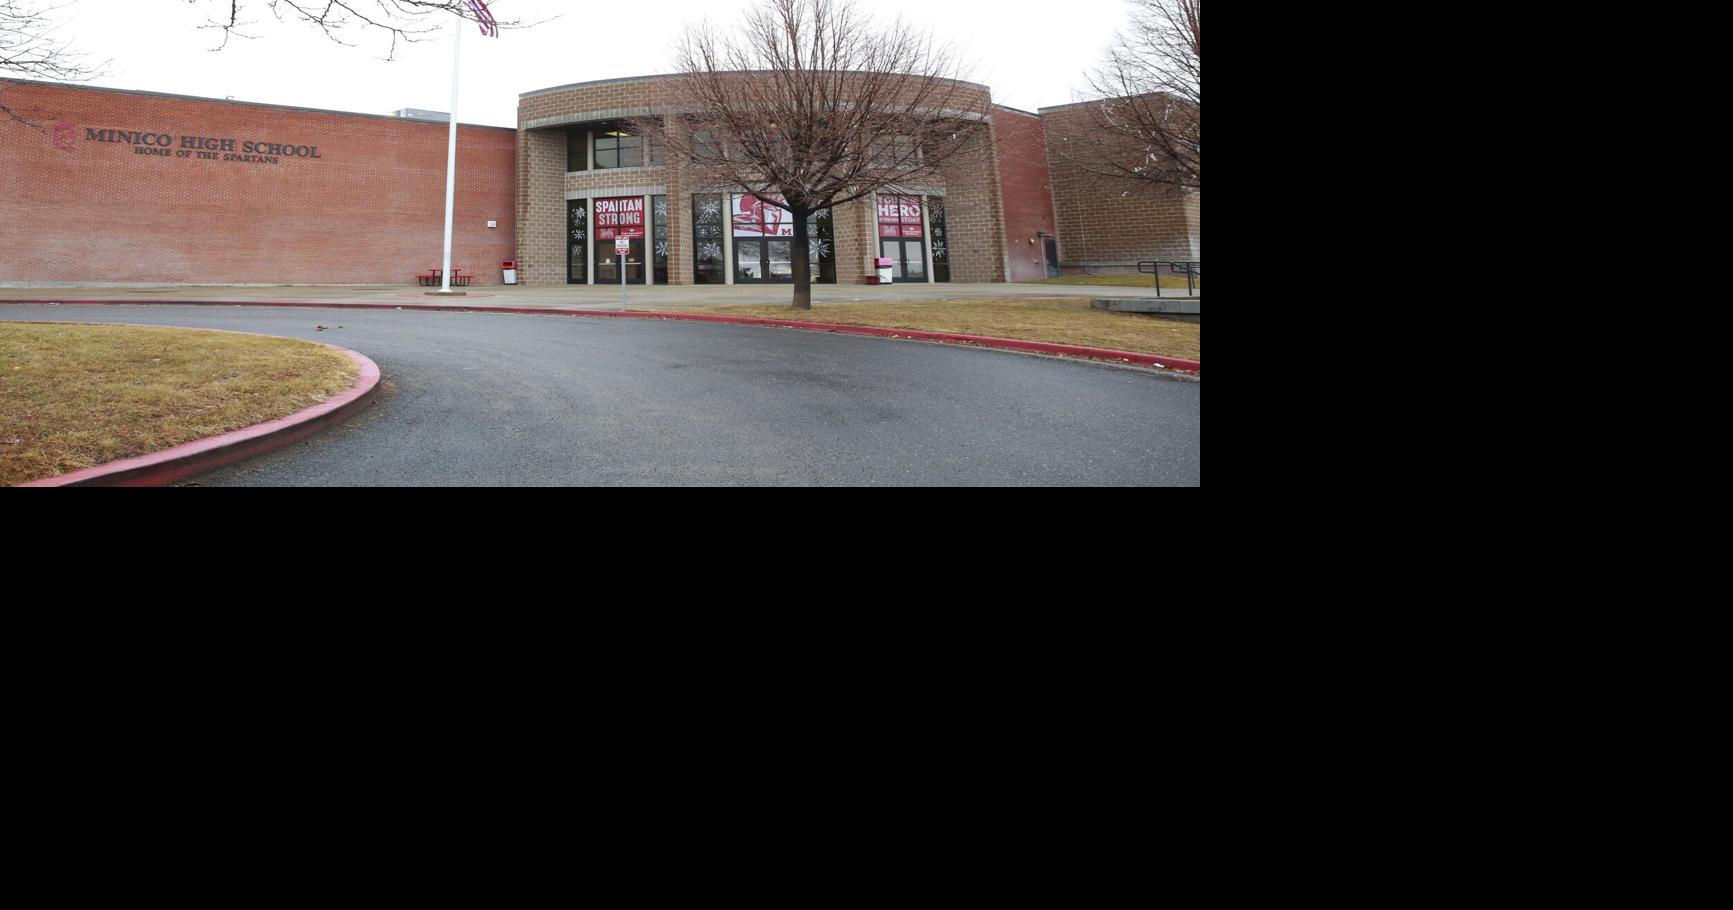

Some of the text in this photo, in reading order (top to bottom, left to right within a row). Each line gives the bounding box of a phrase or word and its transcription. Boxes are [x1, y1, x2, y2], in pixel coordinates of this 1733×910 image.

[85, 127, 321, 159] MINICO HIGH SCHOOL
[134, 146, 279, 164] HOME OF THE SPARTANS
[595, 199, 642, 212] SPARTAN
[878, 204, 920, 216] HERO
[599, 212, 640, 225] STRONG
[781, 228, 793, 236] M
